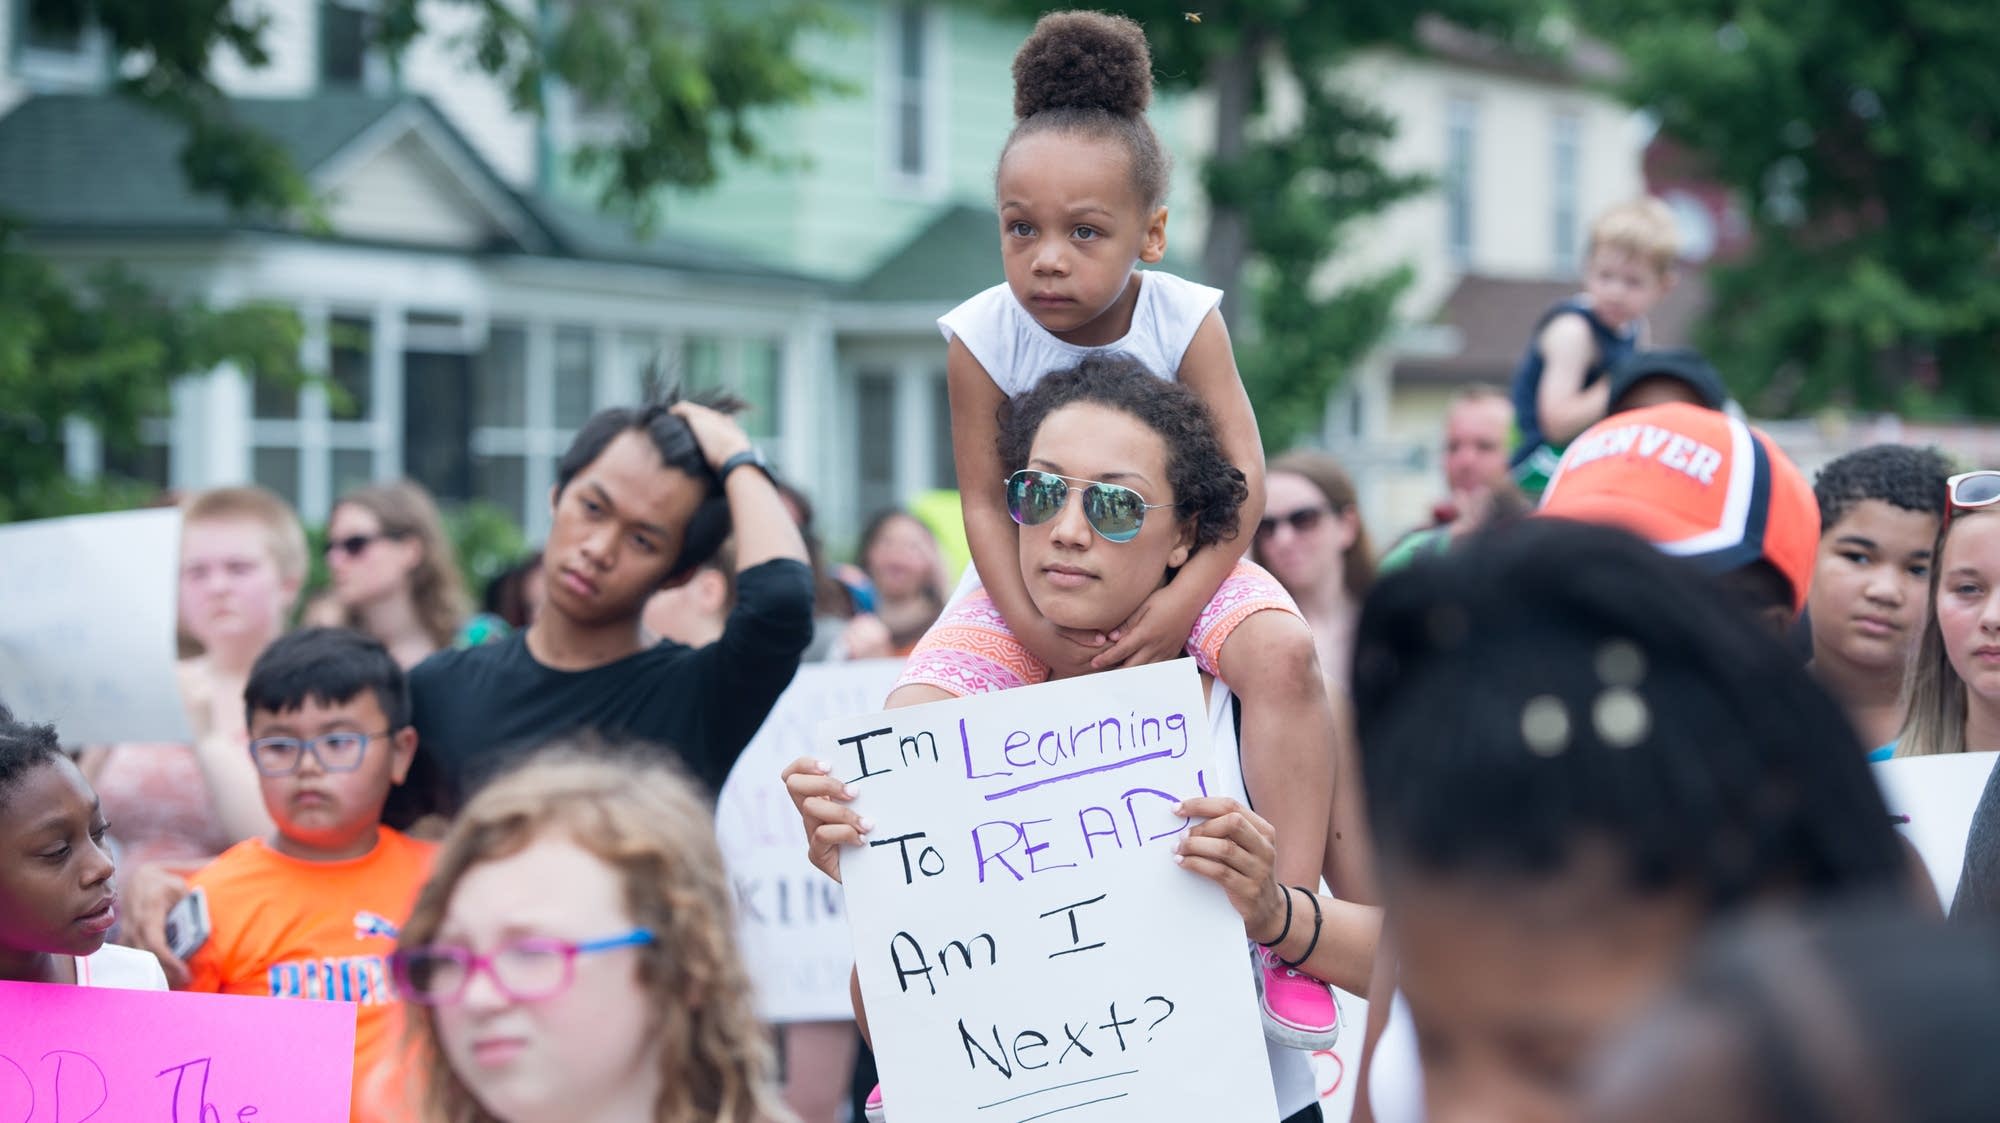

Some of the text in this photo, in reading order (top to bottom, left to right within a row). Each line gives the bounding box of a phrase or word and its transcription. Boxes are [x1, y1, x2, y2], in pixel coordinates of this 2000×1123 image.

[1568, 424, 1723, 486] DENVER
[838, 727, 939, 784] Im
[959, 711, 1188, 779] Learning
[870, 832, 945, 885] To
[890, 931, 996, 995] Am
[1039, 893, 1107, 959] I
[958, 995, 1175, 1080] Next?
